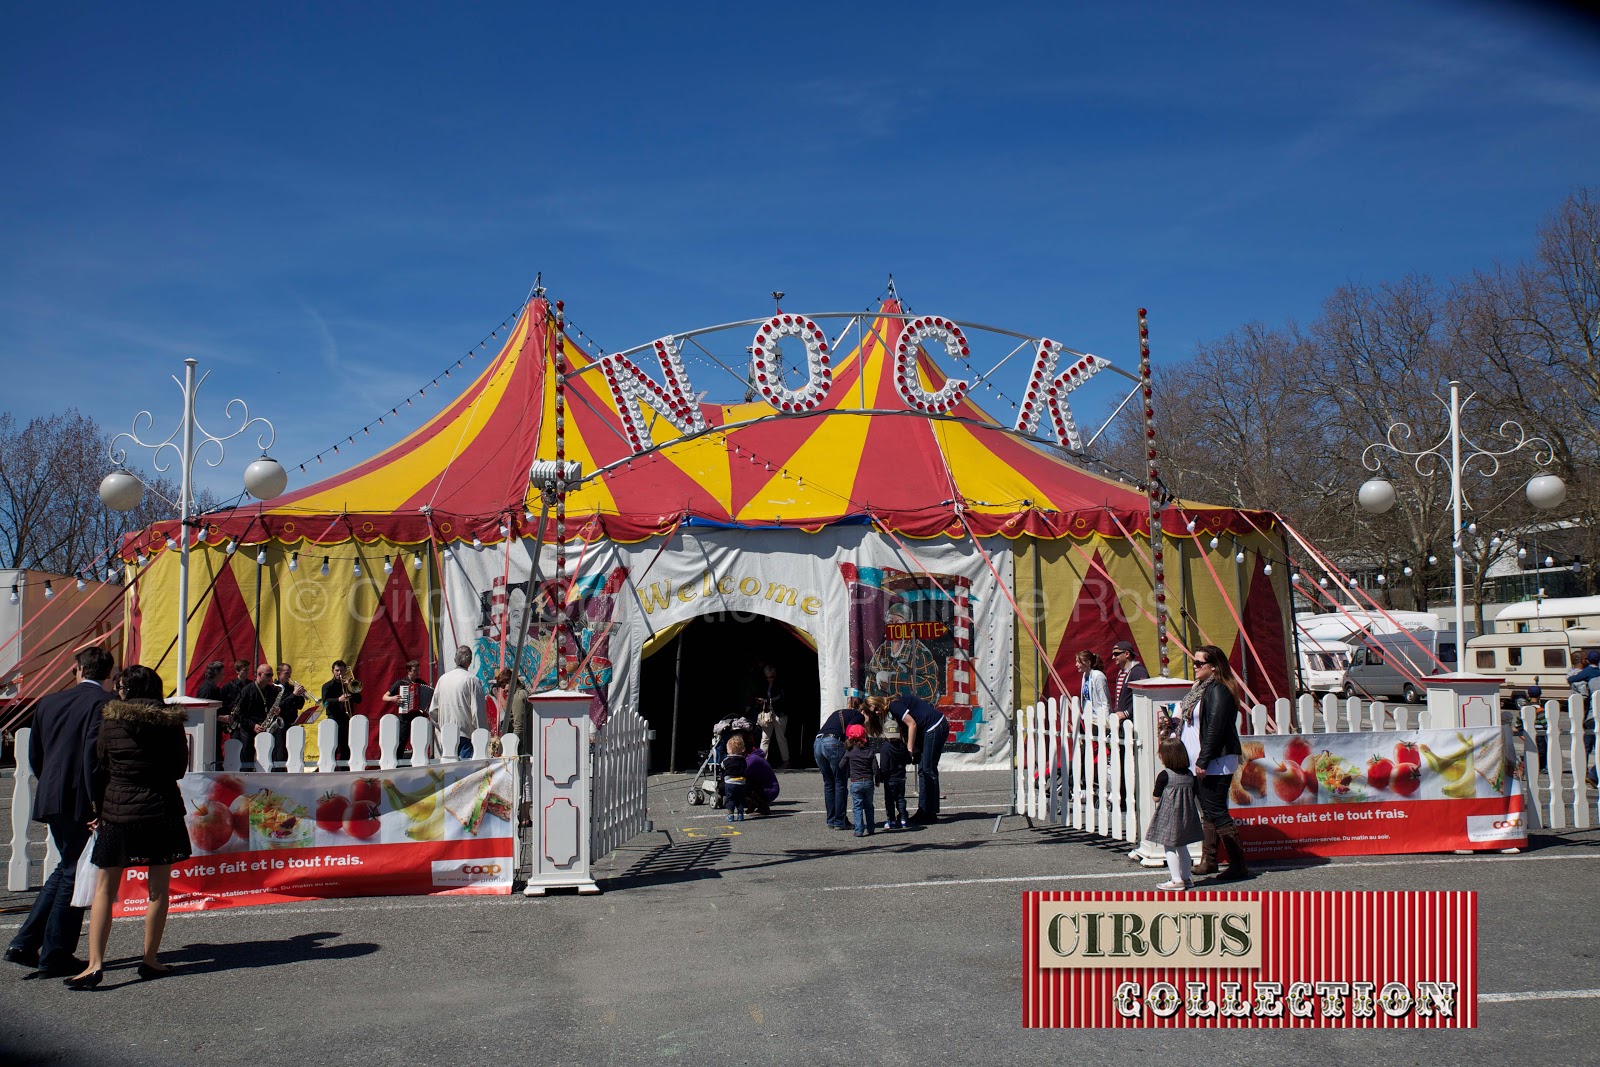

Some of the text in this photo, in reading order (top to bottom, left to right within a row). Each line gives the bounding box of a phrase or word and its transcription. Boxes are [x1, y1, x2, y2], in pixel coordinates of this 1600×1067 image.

[599, 312, 1111, 455] NOCK
[637, 569, 823, 616] Welcome
[567, 673, 604, 687] OCK
[1257, 815, 1269, 825] le
[1270, 813, 1295, 824] vite
[1296, 812, 1318, 823] fait
[1319, 811, 1332, 822] et
[1333, 811, 1345, 821] le
[1346, 809, 1374, 820] tout
[1375, 808, 1409, 819] frais.
[1492, 818, 1523, 829] coop
[126, 869, 149, 881] Pou
[184, 865, 216, 878] vite
[219, 861, 248, 875] fait
[250, 859, 267, 871] et
[270, 859, 285, 870] le
[288, 856, 322, 868] tout
[324, 854, 364, 867] frais.
[461, 864, 502, 876] coop
